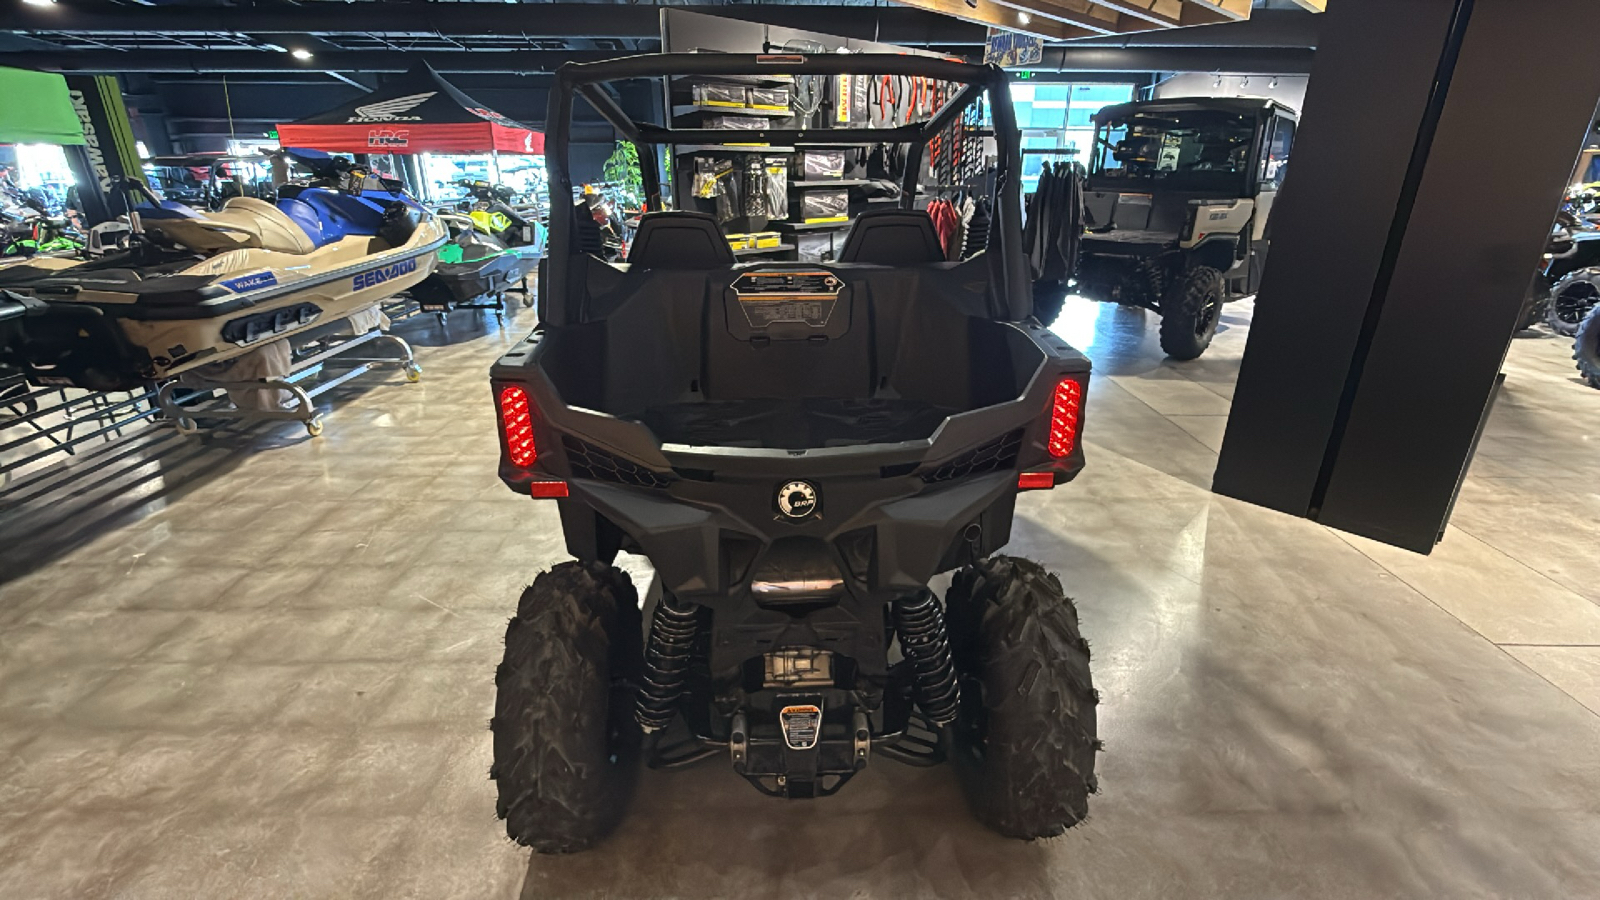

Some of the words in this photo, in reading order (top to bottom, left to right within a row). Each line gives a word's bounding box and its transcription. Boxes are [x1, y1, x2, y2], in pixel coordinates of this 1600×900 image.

[347, 115, 422, 123] HONDA
[368, 129, 409, 147] HRC
[793, 499, 814, 507] BRP
